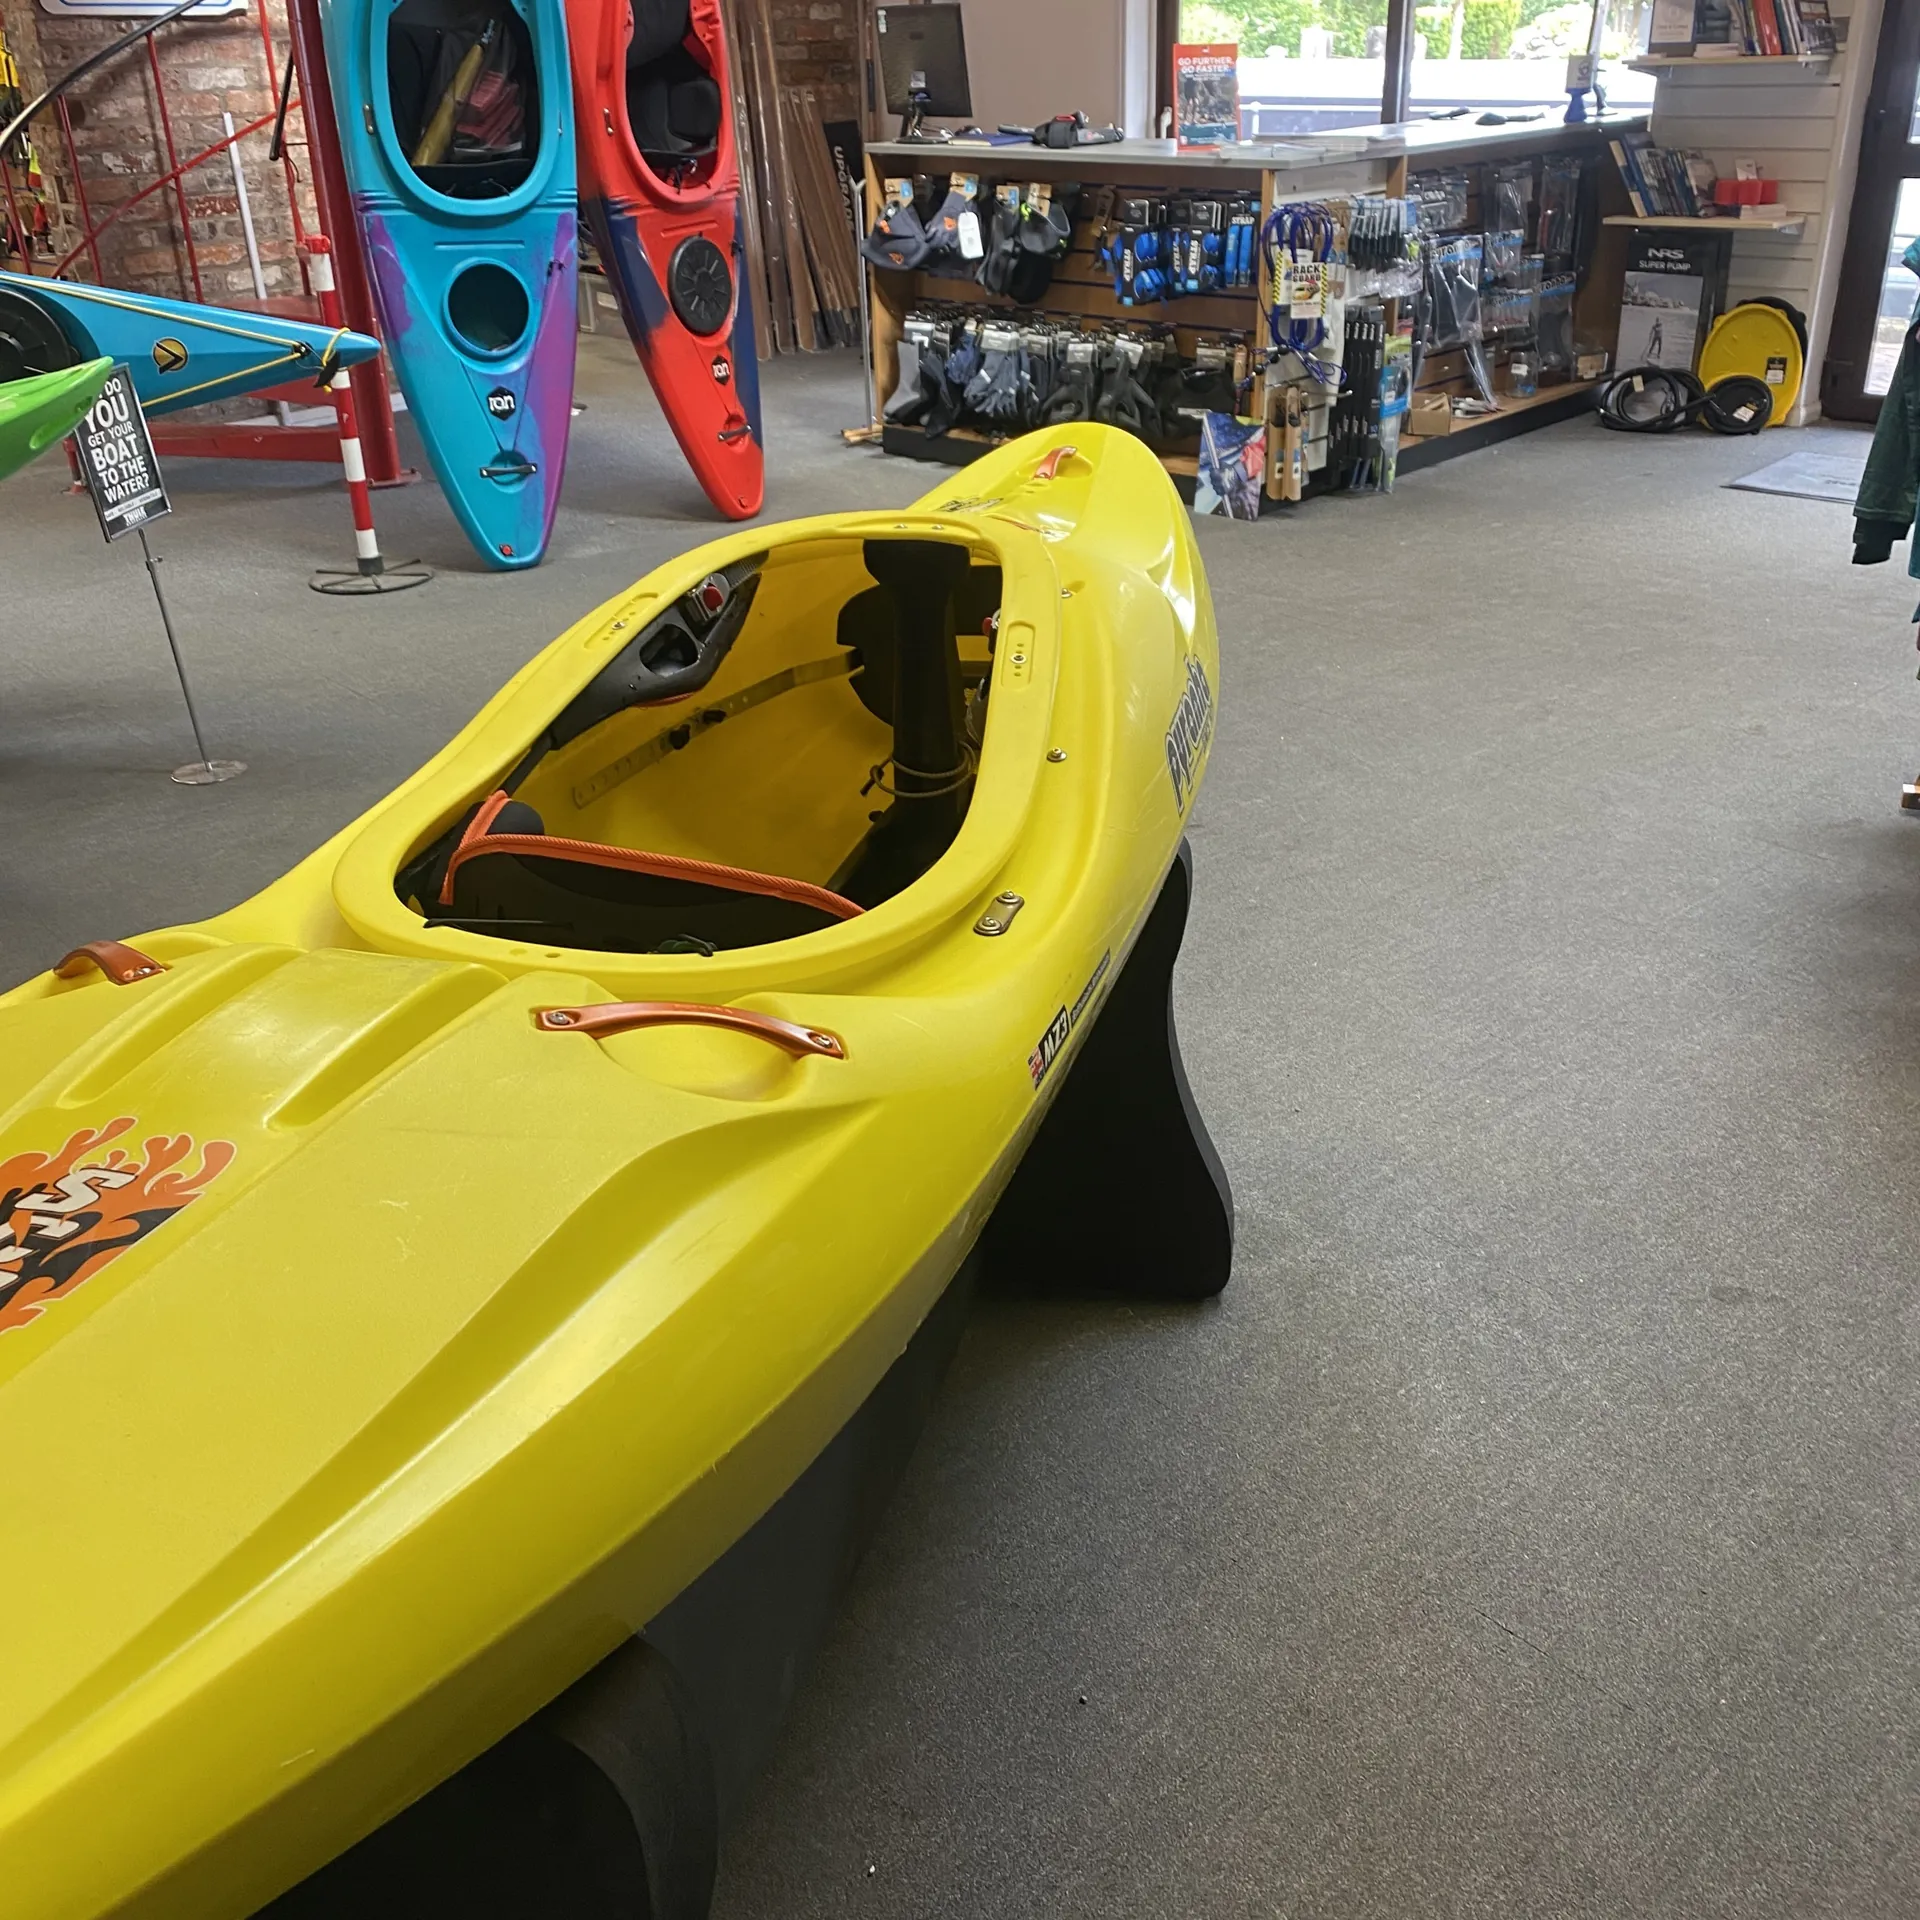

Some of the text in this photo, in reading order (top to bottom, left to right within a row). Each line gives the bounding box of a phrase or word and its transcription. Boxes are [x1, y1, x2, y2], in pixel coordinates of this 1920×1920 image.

[1177, 56, 1235, 66] GO FURTHER.
[1181, 64, 1232, 74] GO FASTER.
[1231, 216, 1256, 225] STRAP
[1188, 239, 1200, 276] STRAP
[1647, 247, 1685, 259] NRS
[1293, 264, 1320, 275] RACK
[1639, 259, 1692, 271] SUPER PUMP
[1292, 273, 1321, 283] GUARD
[104, 378, 122, 396] DO
[84, 393, 130, 434] YOU
[88, 421, 135, 448] GET YOUR
[90, 434, 140, 472] BOAT
[98, 455, 147, 488] TO THE
[104, 473, 150, 504] WATER?
